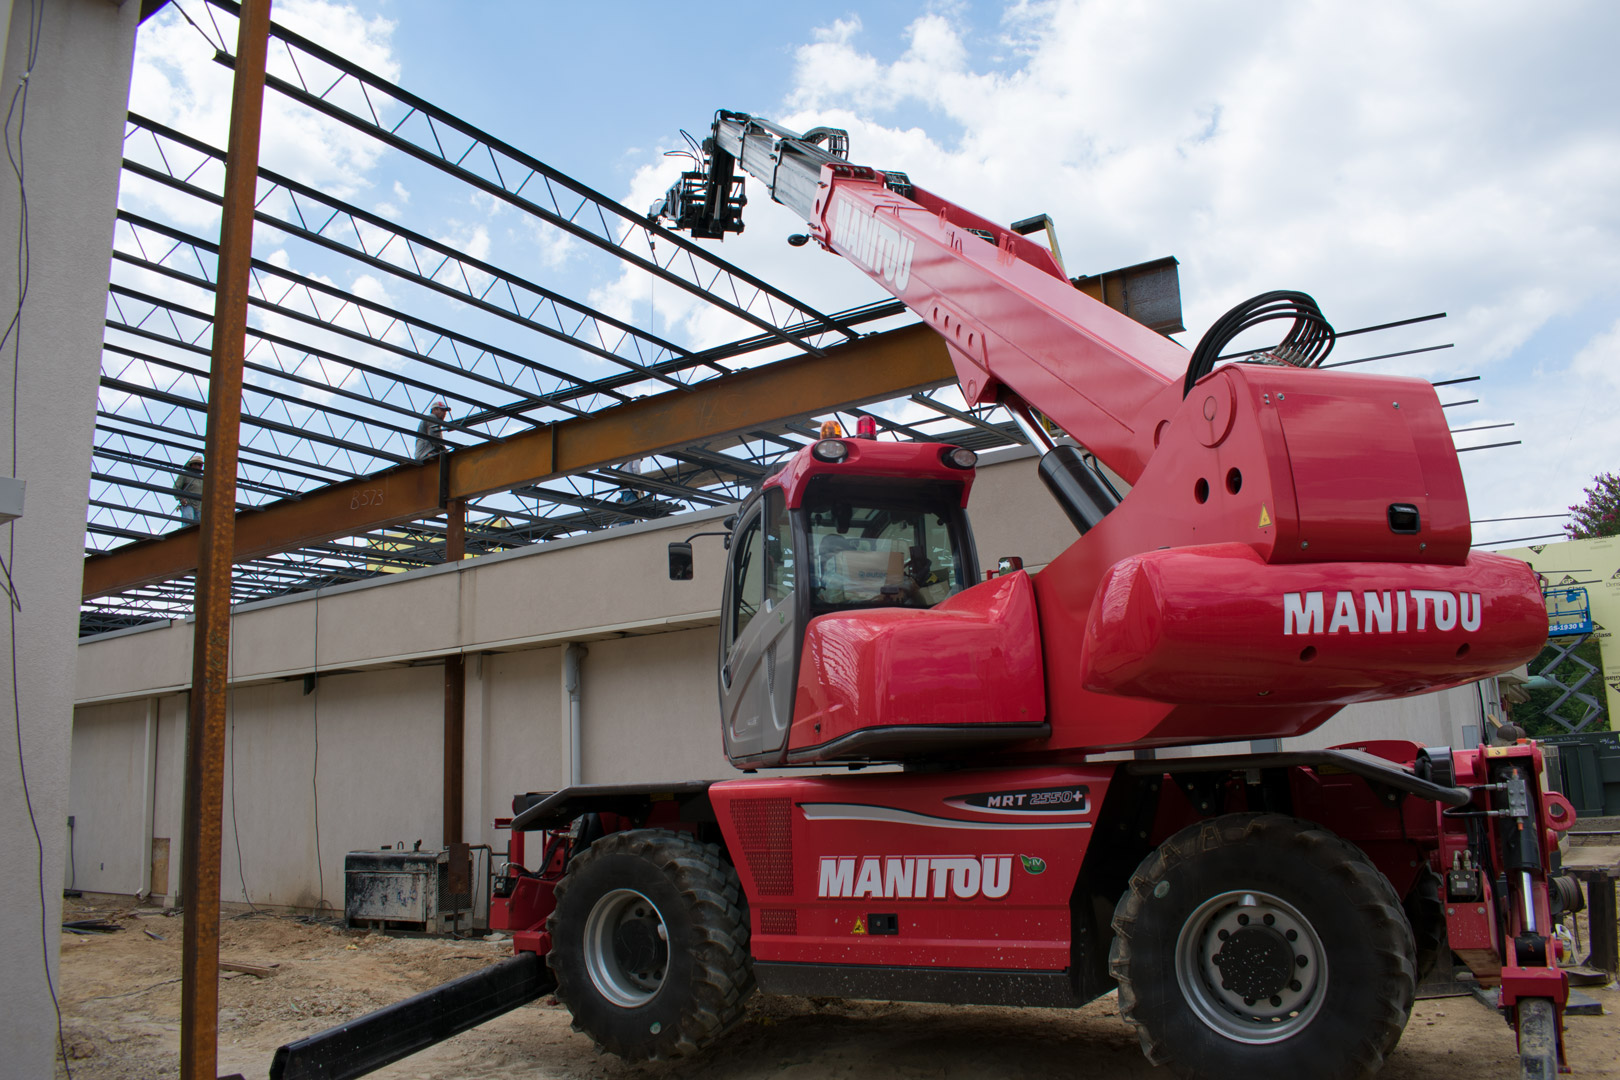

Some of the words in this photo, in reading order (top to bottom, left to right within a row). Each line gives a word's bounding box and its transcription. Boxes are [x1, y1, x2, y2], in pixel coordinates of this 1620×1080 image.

[831, 198, 916, 292] MANITOU
[350, 489, 384, 510] B573
[1283, 589, 1482, 635] MANITOU
[988, 794, 1027, 808] MRT
[1029, 790, 1083, 805] 2550+
[818, 854, 1015, 900] MANITOU
